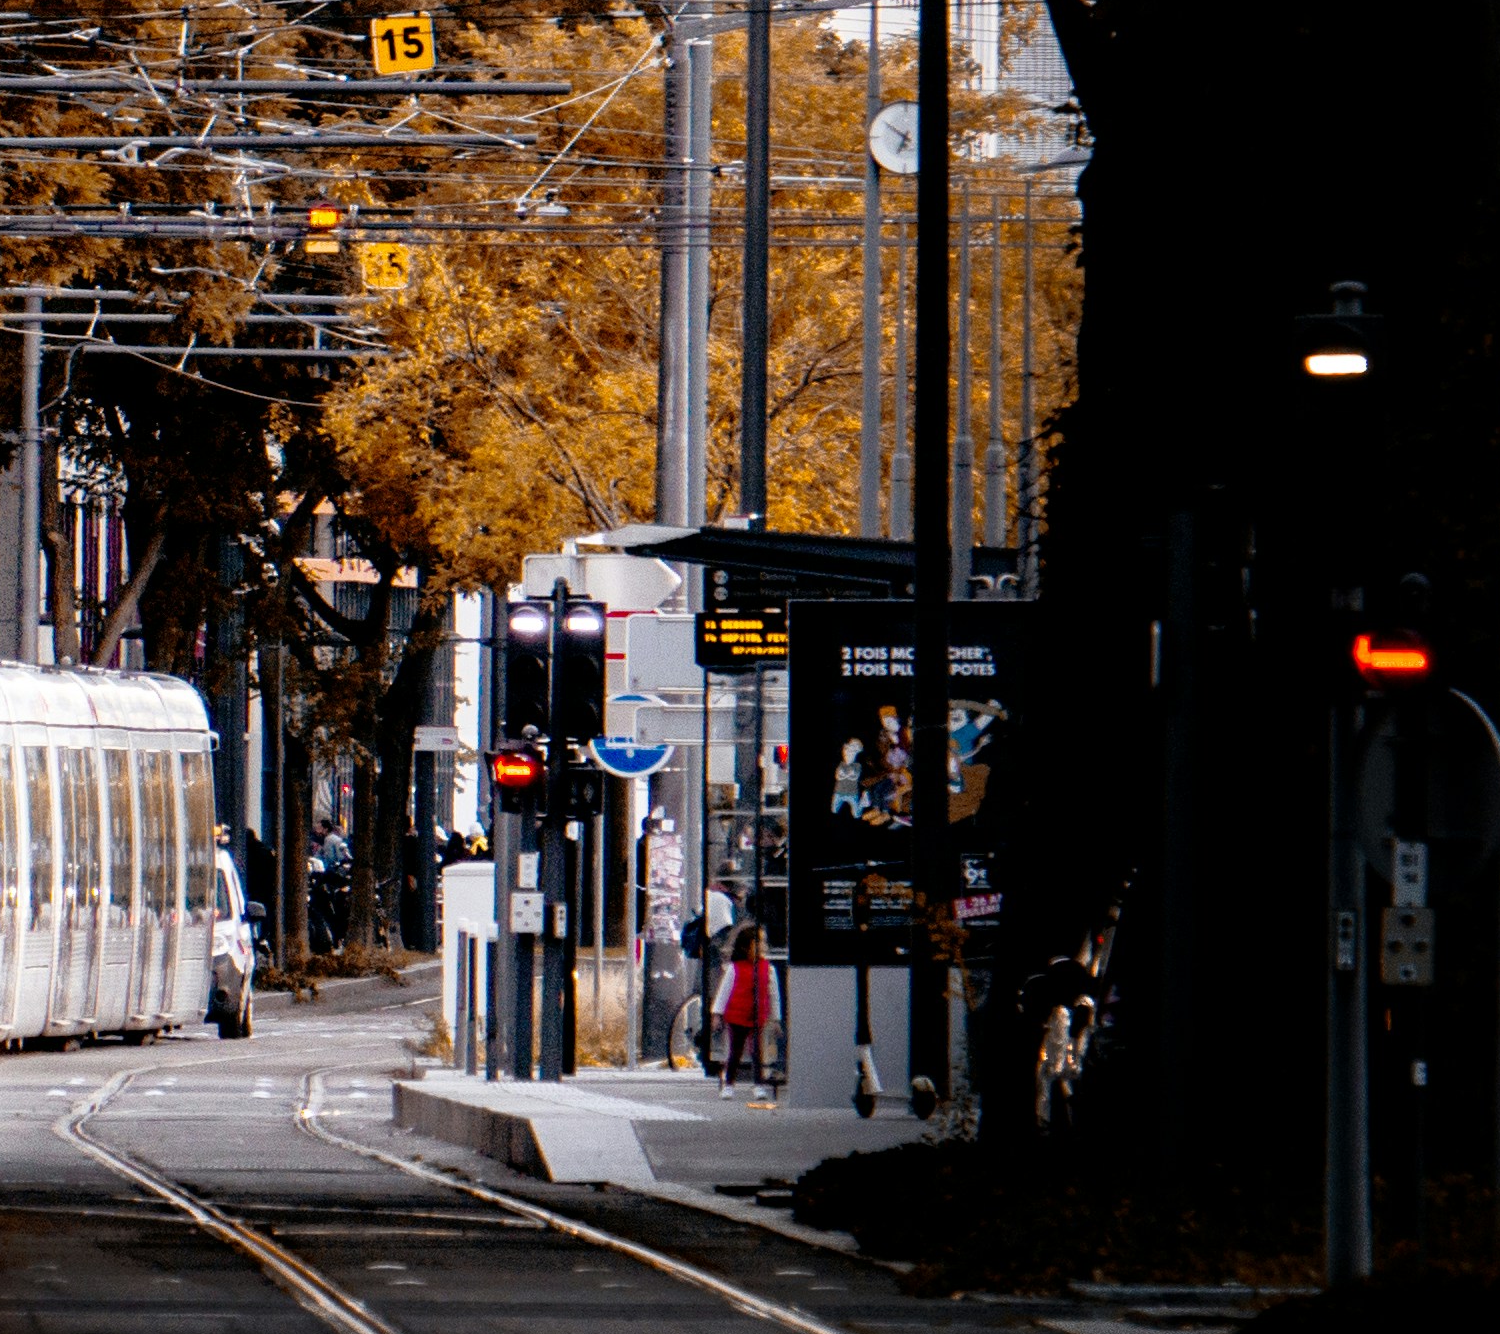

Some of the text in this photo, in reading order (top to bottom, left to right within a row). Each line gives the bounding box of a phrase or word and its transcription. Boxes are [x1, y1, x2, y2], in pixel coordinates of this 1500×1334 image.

[381, 26, 425, 61] 15
[841, 646, 852, 661] 2
[854, 646, 889, 661] FOIS
[841, 662, 852, 677] 2
[854, 662, 888, 677] FOIS
[950, 662, 996, 677] POTES
